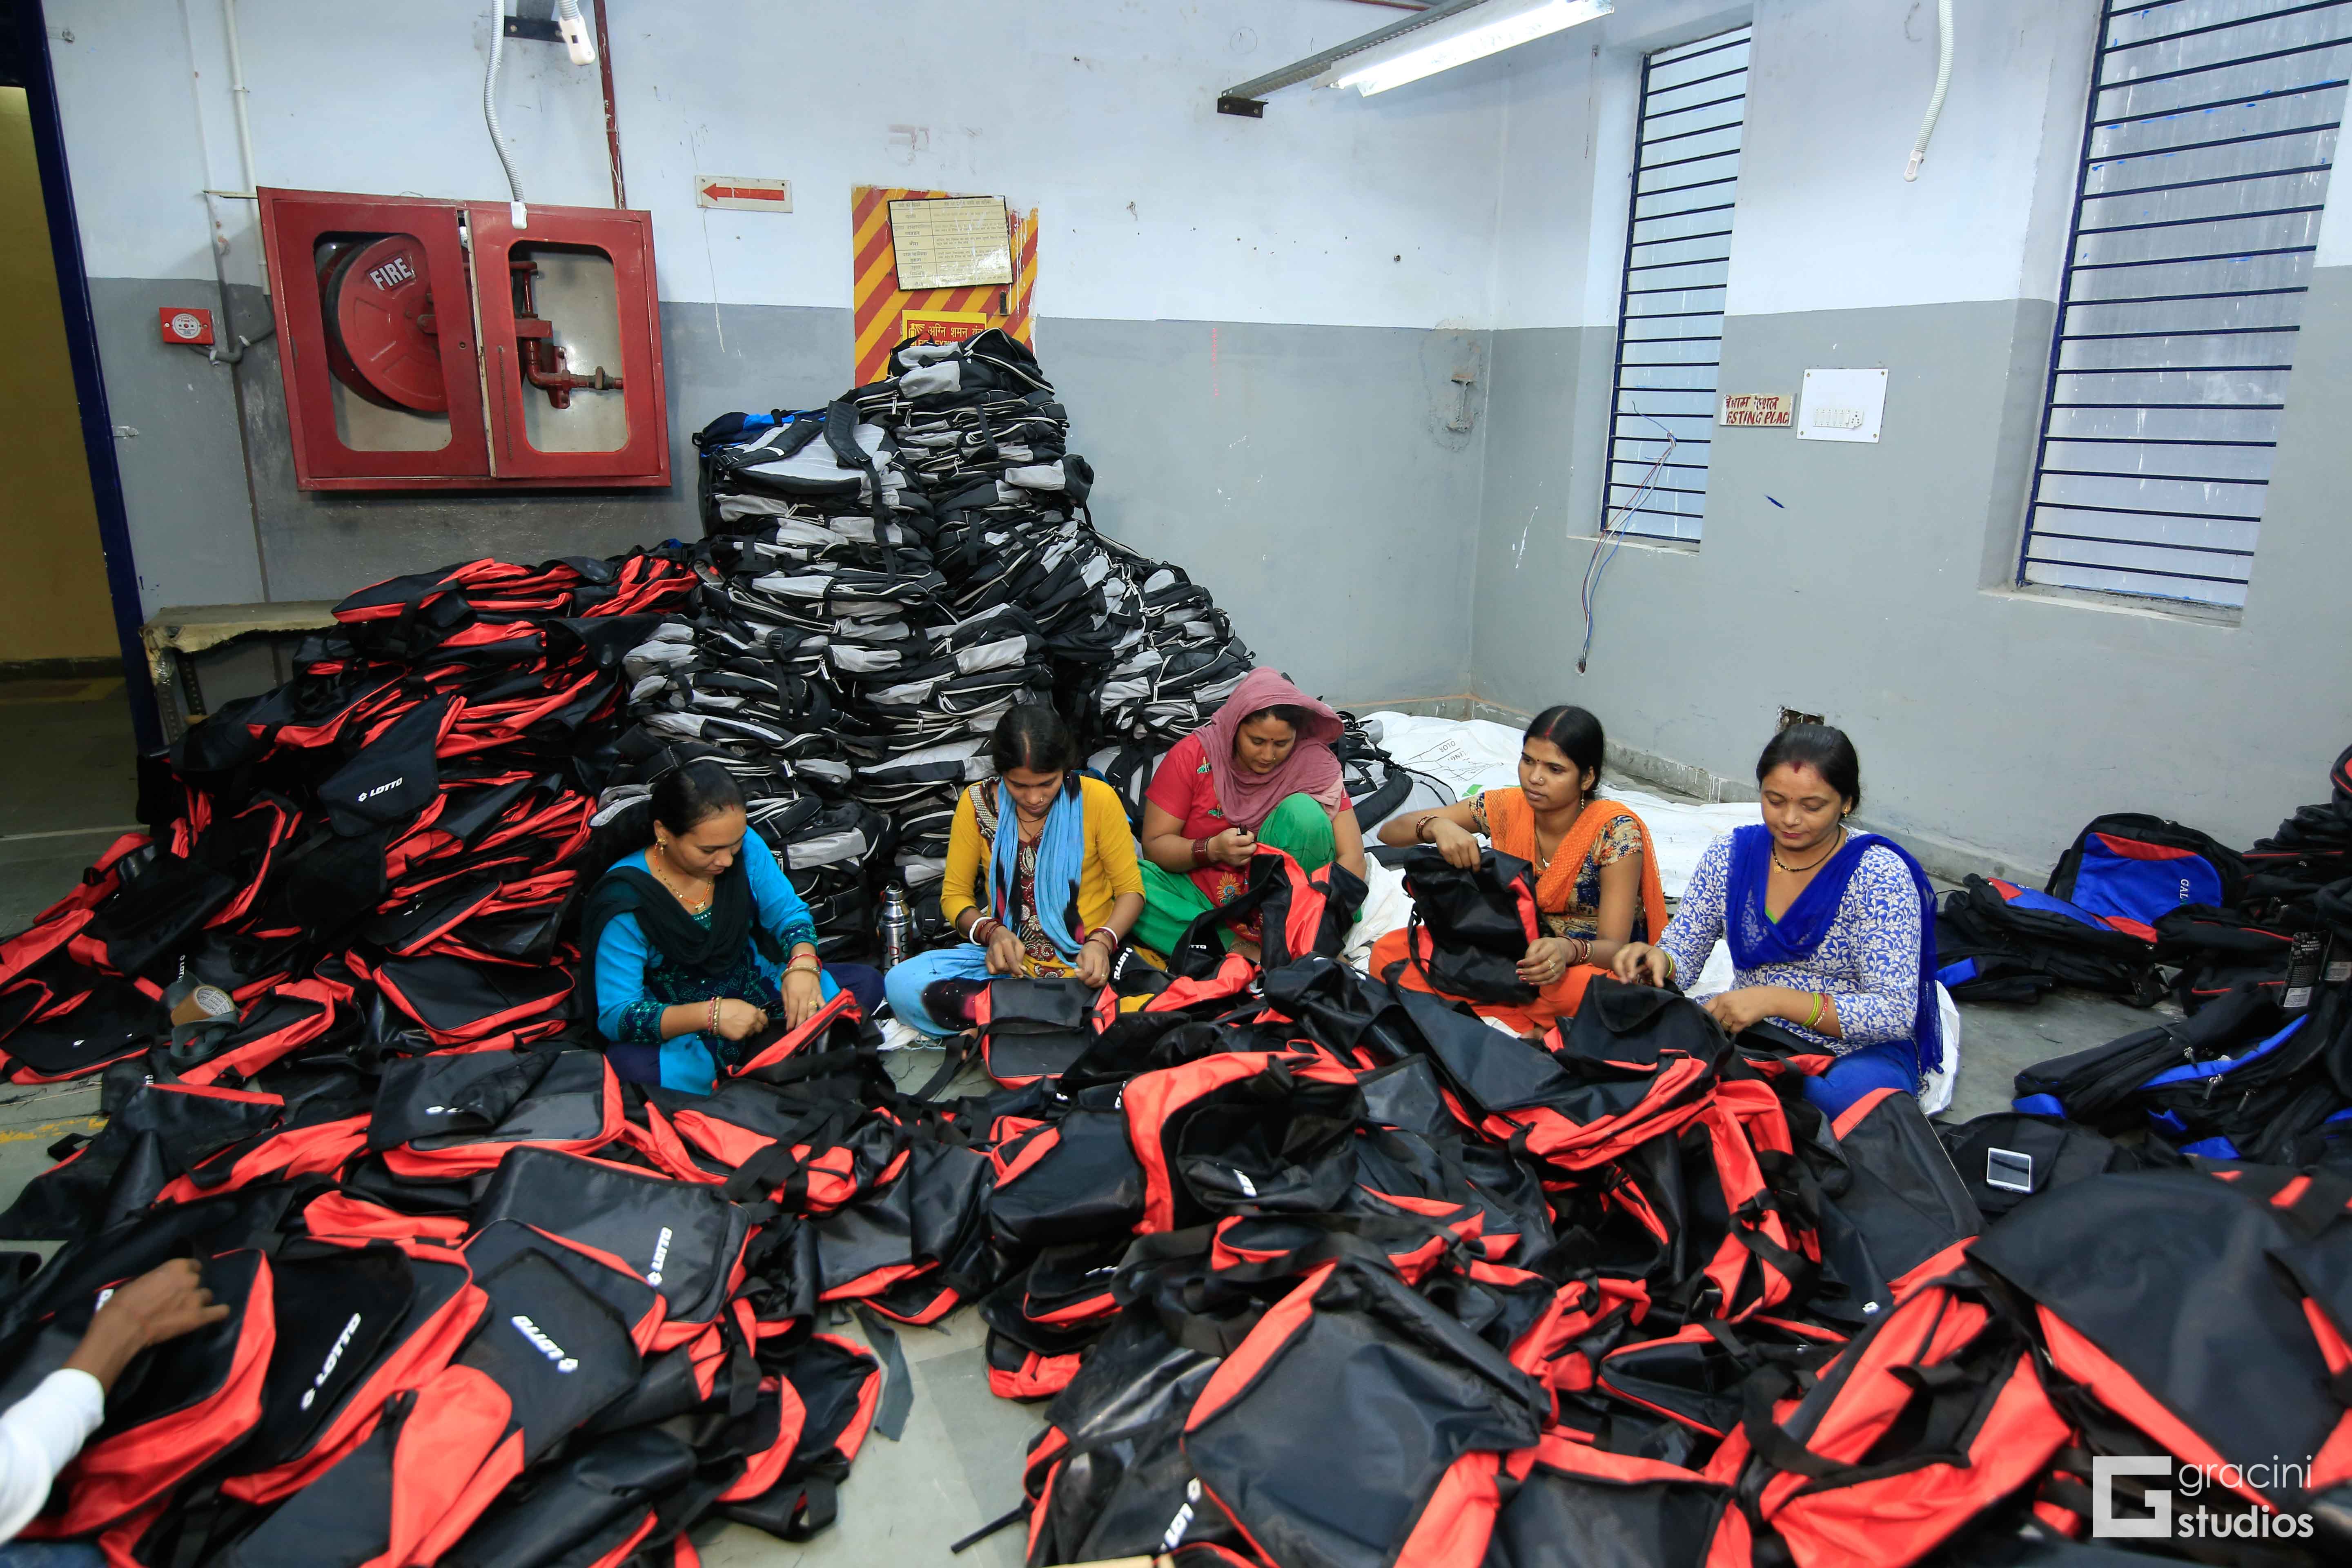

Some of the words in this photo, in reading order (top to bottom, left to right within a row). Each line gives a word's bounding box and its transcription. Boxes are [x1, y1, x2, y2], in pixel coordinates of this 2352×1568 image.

[370, 257, 412, 291] FIRE
[927, 323, 947, 337] अग्नि
[951, 327, 968, 338] शमन
[1764, 411, 1790, 425] PLAC
[370, 777, 403, 797] LOTTO
[1114, 952, 1129, 980] LOTTO
[650, 1225, 673, 1271] LOTTO
[314, 1312, 362, 1387] LOTTO
[510, 1315, 566, 1361] LOTTO
